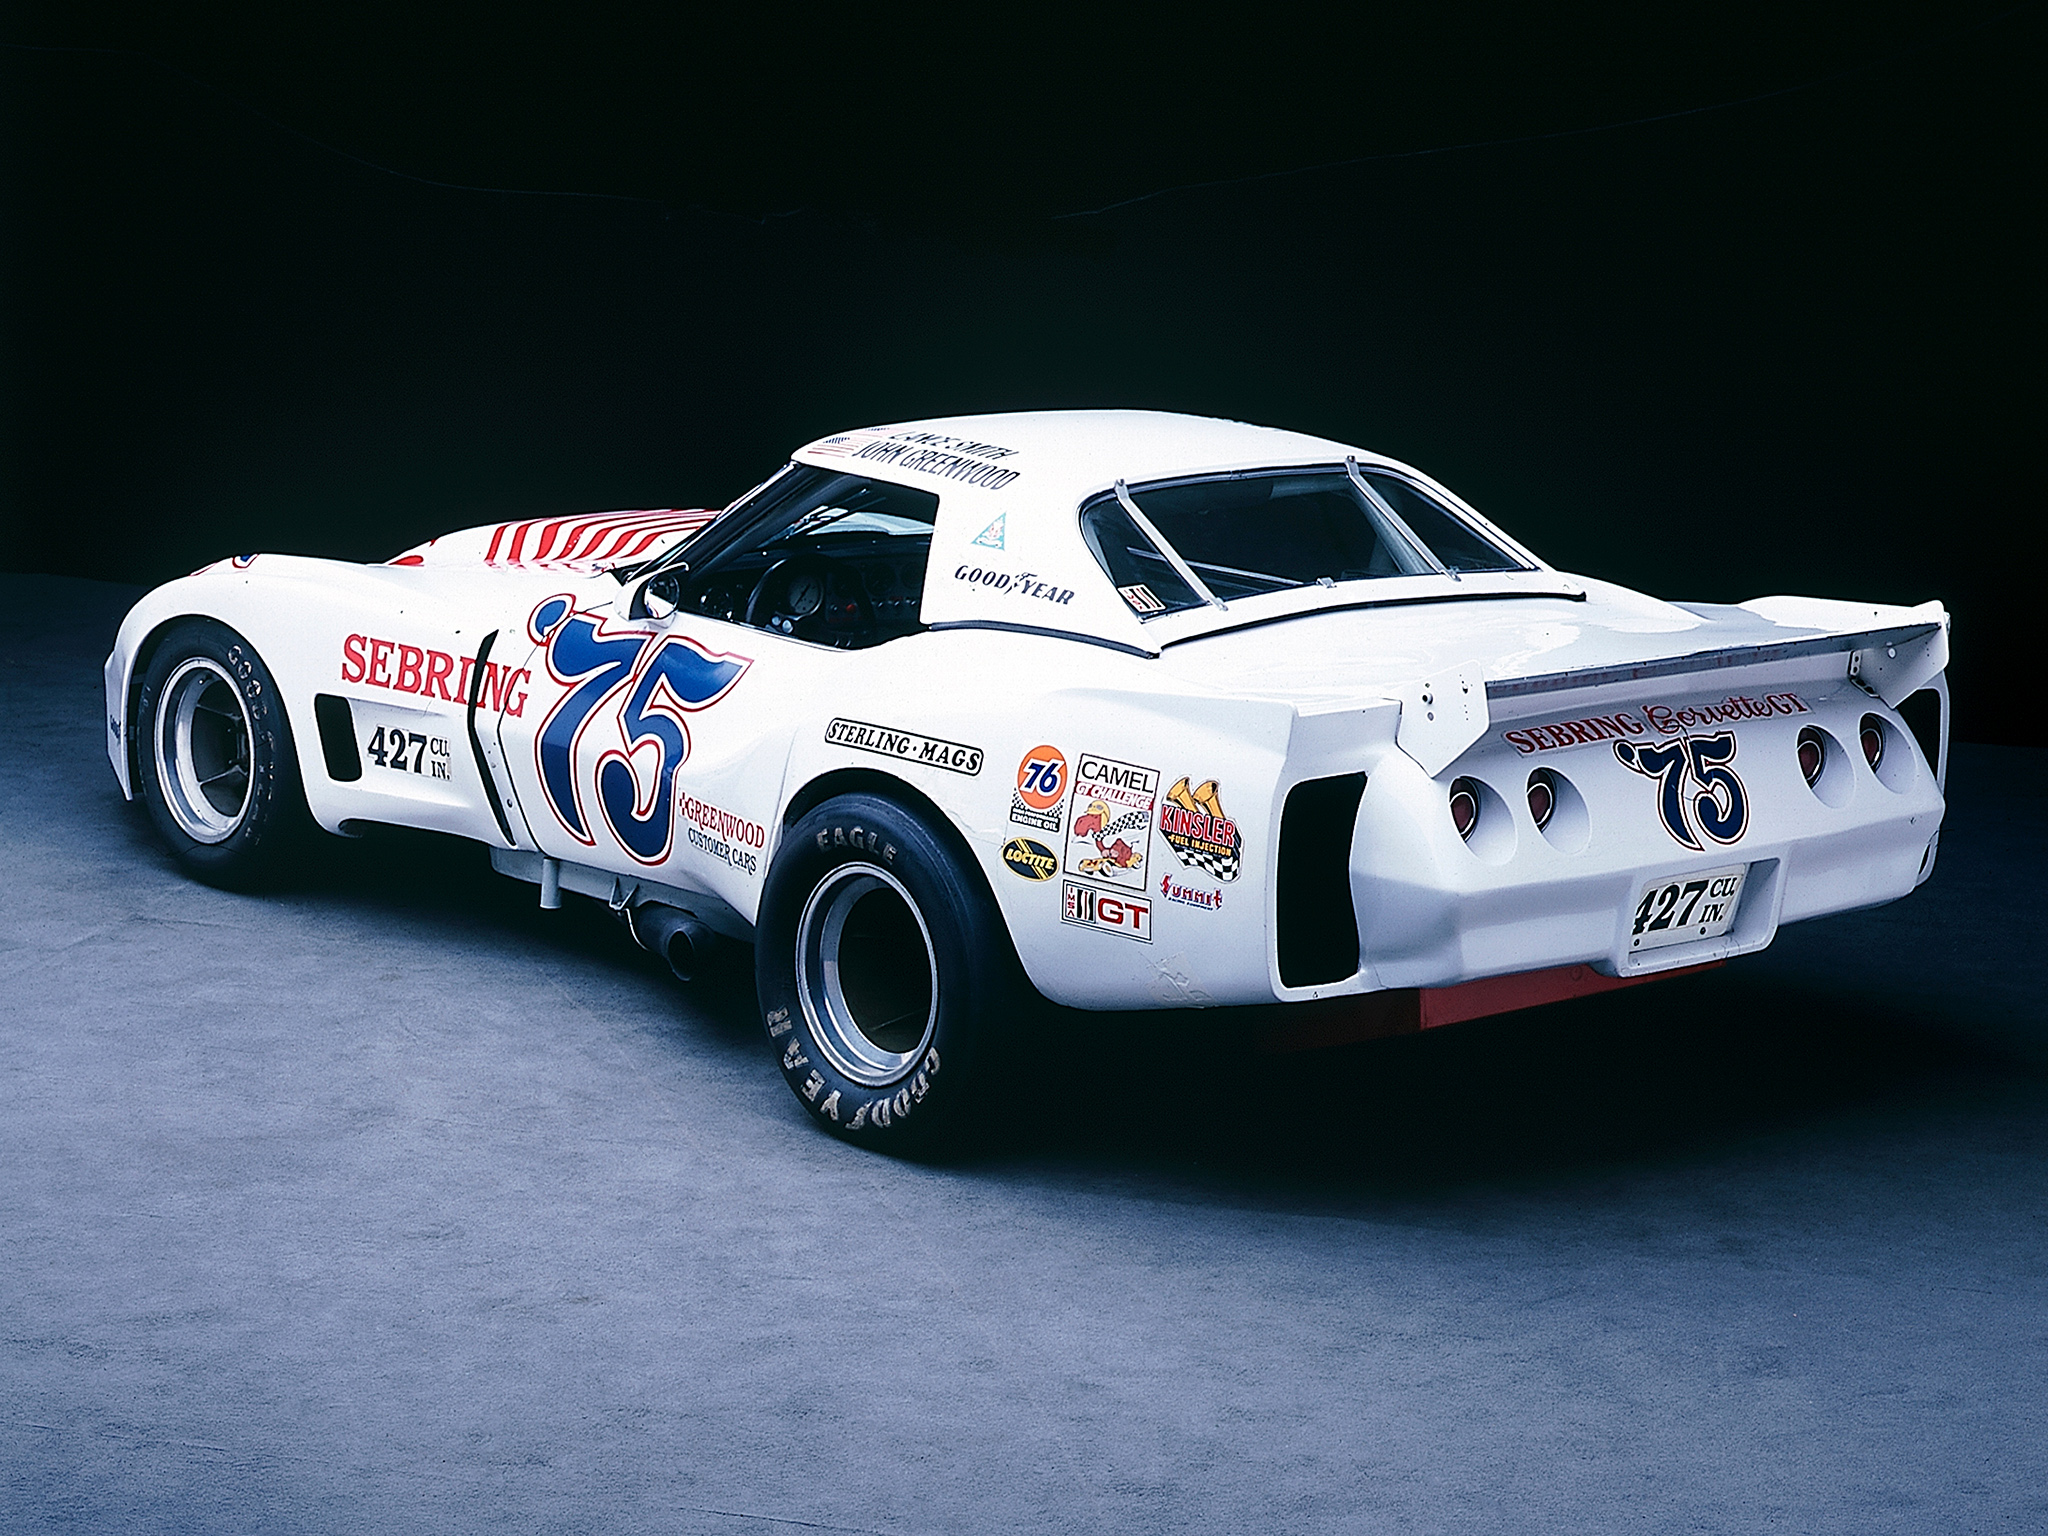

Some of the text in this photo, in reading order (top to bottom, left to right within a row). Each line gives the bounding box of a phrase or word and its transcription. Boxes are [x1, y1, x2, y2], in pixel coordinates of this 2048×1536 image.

[852, 440, 1021, 490] JOHN GREENWOOD
[341, 633, 532, 718] SEBRING
[1505, 692, 1808, 753] SEBRING Corvette GT
[367, 726, 450, 774] 427 CU.
[828, 722, 981, 772] STERLING MAGS
[431, 760, 450, 781] IN.
[1022, 760, 1063, 796] 76
[1081, 760, 1154, 794] CAMEL
[1075, 783, 1153, 810] GT CHALLENGE
[687, 797, 765, 849] GREENWOOD
[1011, 813, 1043, 828] ENGINE
[1043, 820, 1059, 832] OIL
[1160, 805, 1236, 848] KINSLER
[688, 827, 757, 876] CUSTOMER CARS
[816, 826, 898, 866] EAGLE
[1005, 848, 1056, 870] LOCTITE
[1167, 834, 1190, 847] FUEL
[1191, 839, 1232, 858] INJECTION
[1097, 897, 1149, 930] GT
[1631, 877, 1737, 936] 427 CU.
[1698, 903, 1724, 924] IN.
